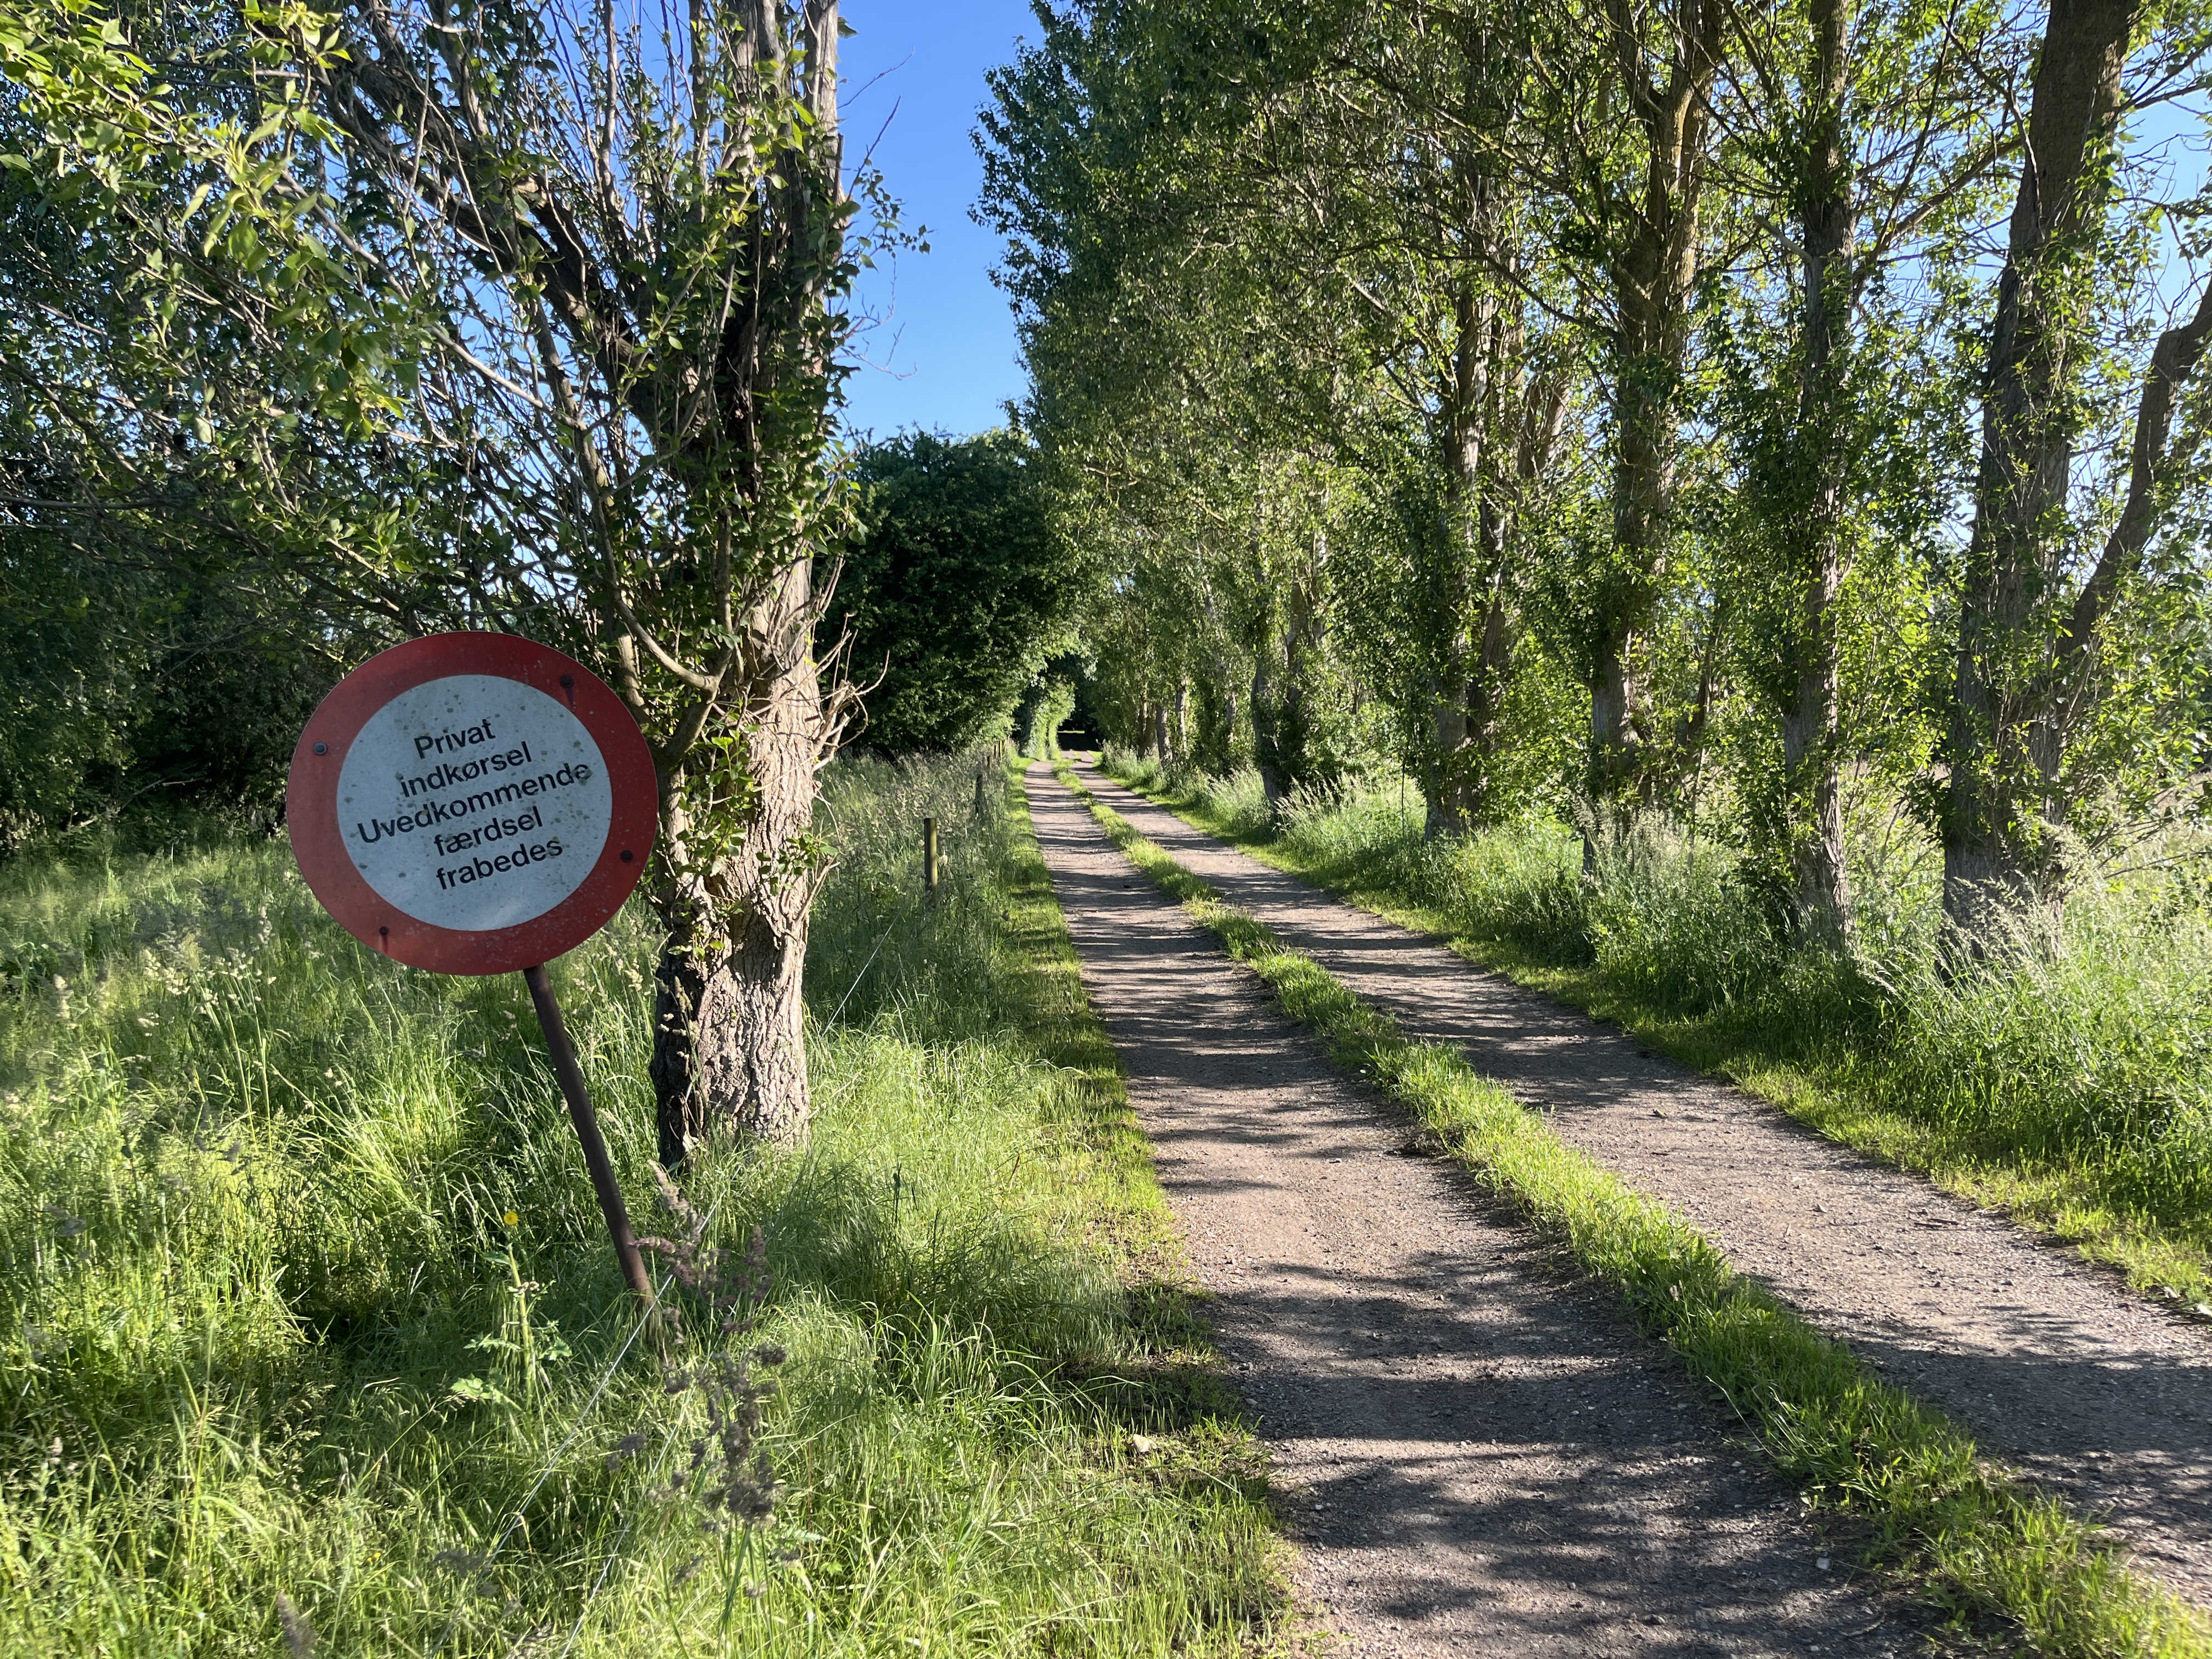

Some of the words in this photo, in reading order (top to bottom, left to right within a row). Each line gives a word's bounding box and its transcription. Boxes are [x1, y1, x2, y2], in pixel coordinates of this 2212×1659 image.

[414, 719, 495, 759] Privat
[399, 741, 533, 798] indkørsel
[358, 763, 591, 844] Uvedkommende
[434, 806, 544, 856] færdsel
[436, 838, 563, 890] frabedes
